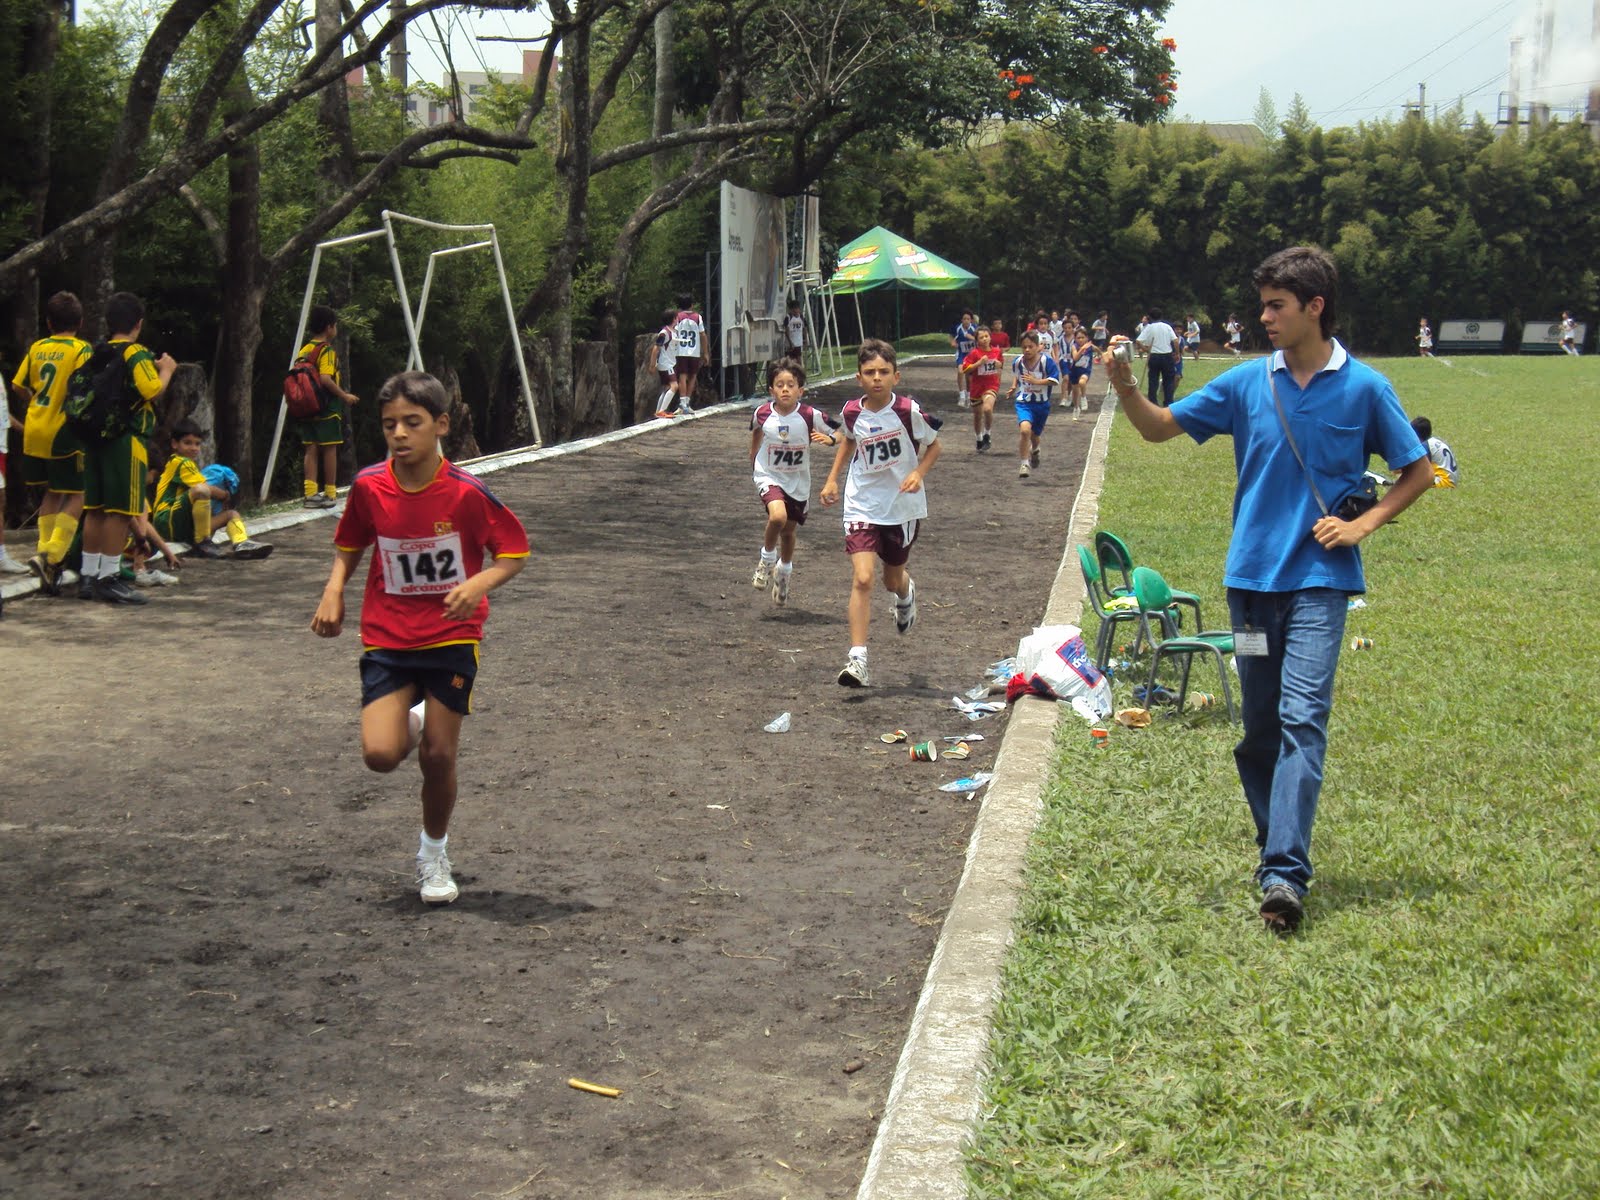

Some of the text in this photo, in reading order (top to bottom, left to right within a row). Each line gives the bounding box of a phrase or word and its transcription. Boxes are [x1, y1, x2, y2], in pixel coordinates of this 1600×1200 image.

[680, 330, 696, 348] 33
[37, 362, 57, 407] 2
[773, 450, 804, 466] 742
[865, 438, 902, 465] 738
[397, 548, 458, 584] 142
